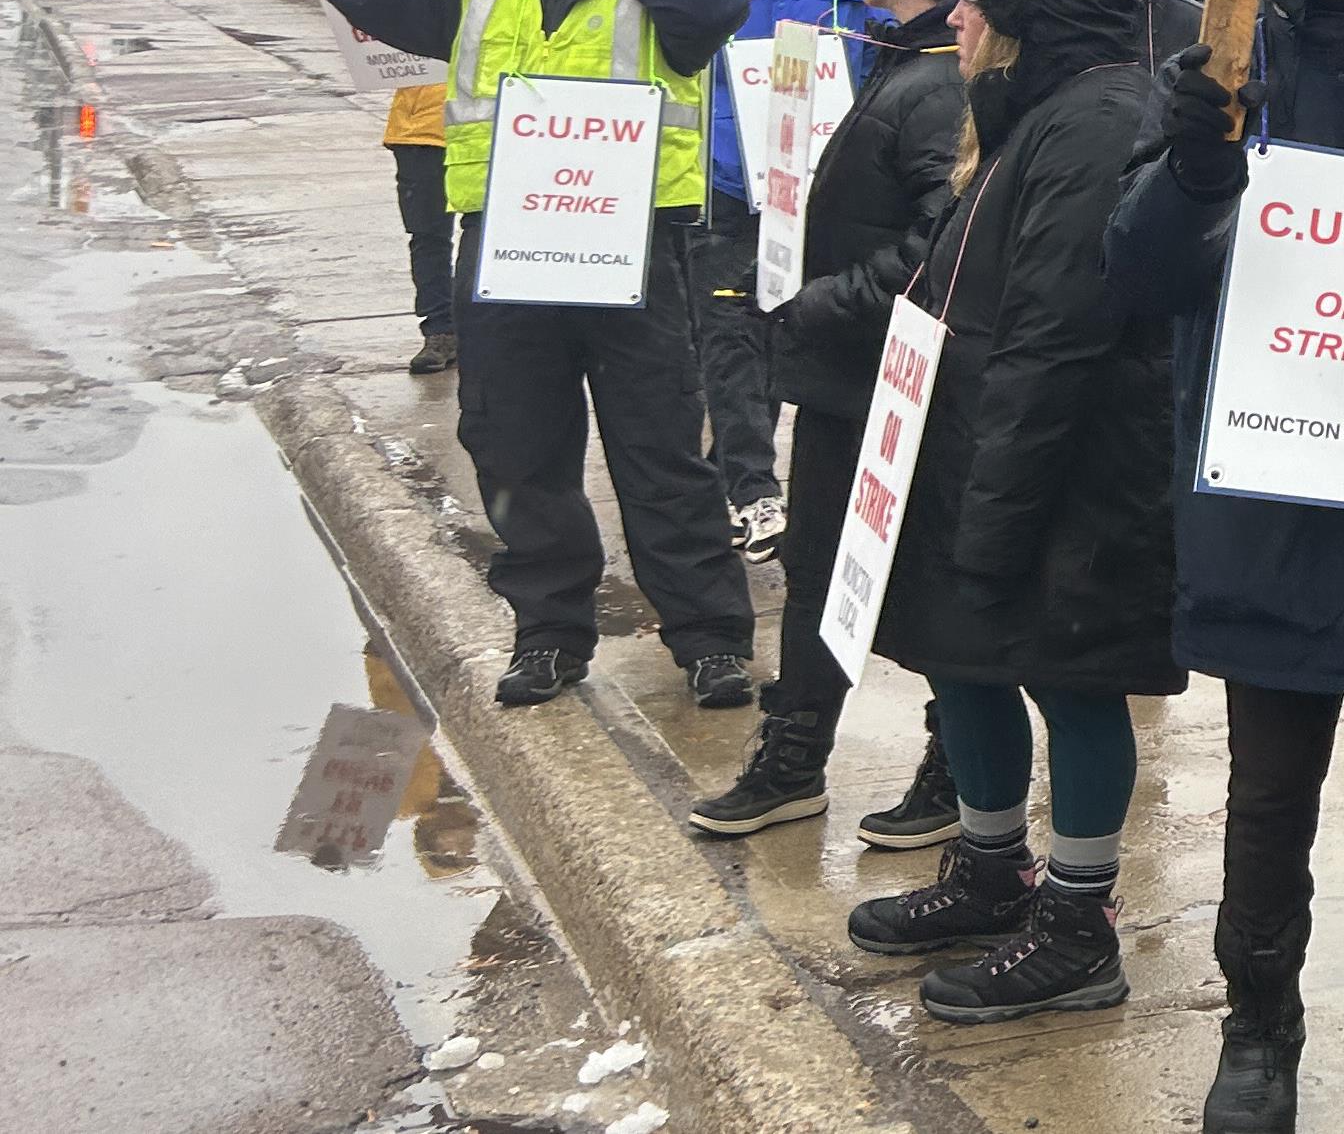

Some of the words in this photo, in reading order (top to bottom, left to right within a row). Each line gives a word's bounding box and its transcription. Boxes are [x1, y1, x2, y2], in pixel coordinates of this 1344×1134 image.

[366, 52, 430, 66] MONCTO
[379, 63, 429, 79] LOCALE
[512, 113, 646, 144] C.U.P.W
[553, 168, 594, 187] ON
[522, 192, 620, 215] STRIKE
[494, 249, 576, 264] MONCTON
[579, 252, 633, 266] LOCAL
[1227, 409, 1341, 441] MONCTON
[854, 467, 898, 544] STRIKE
